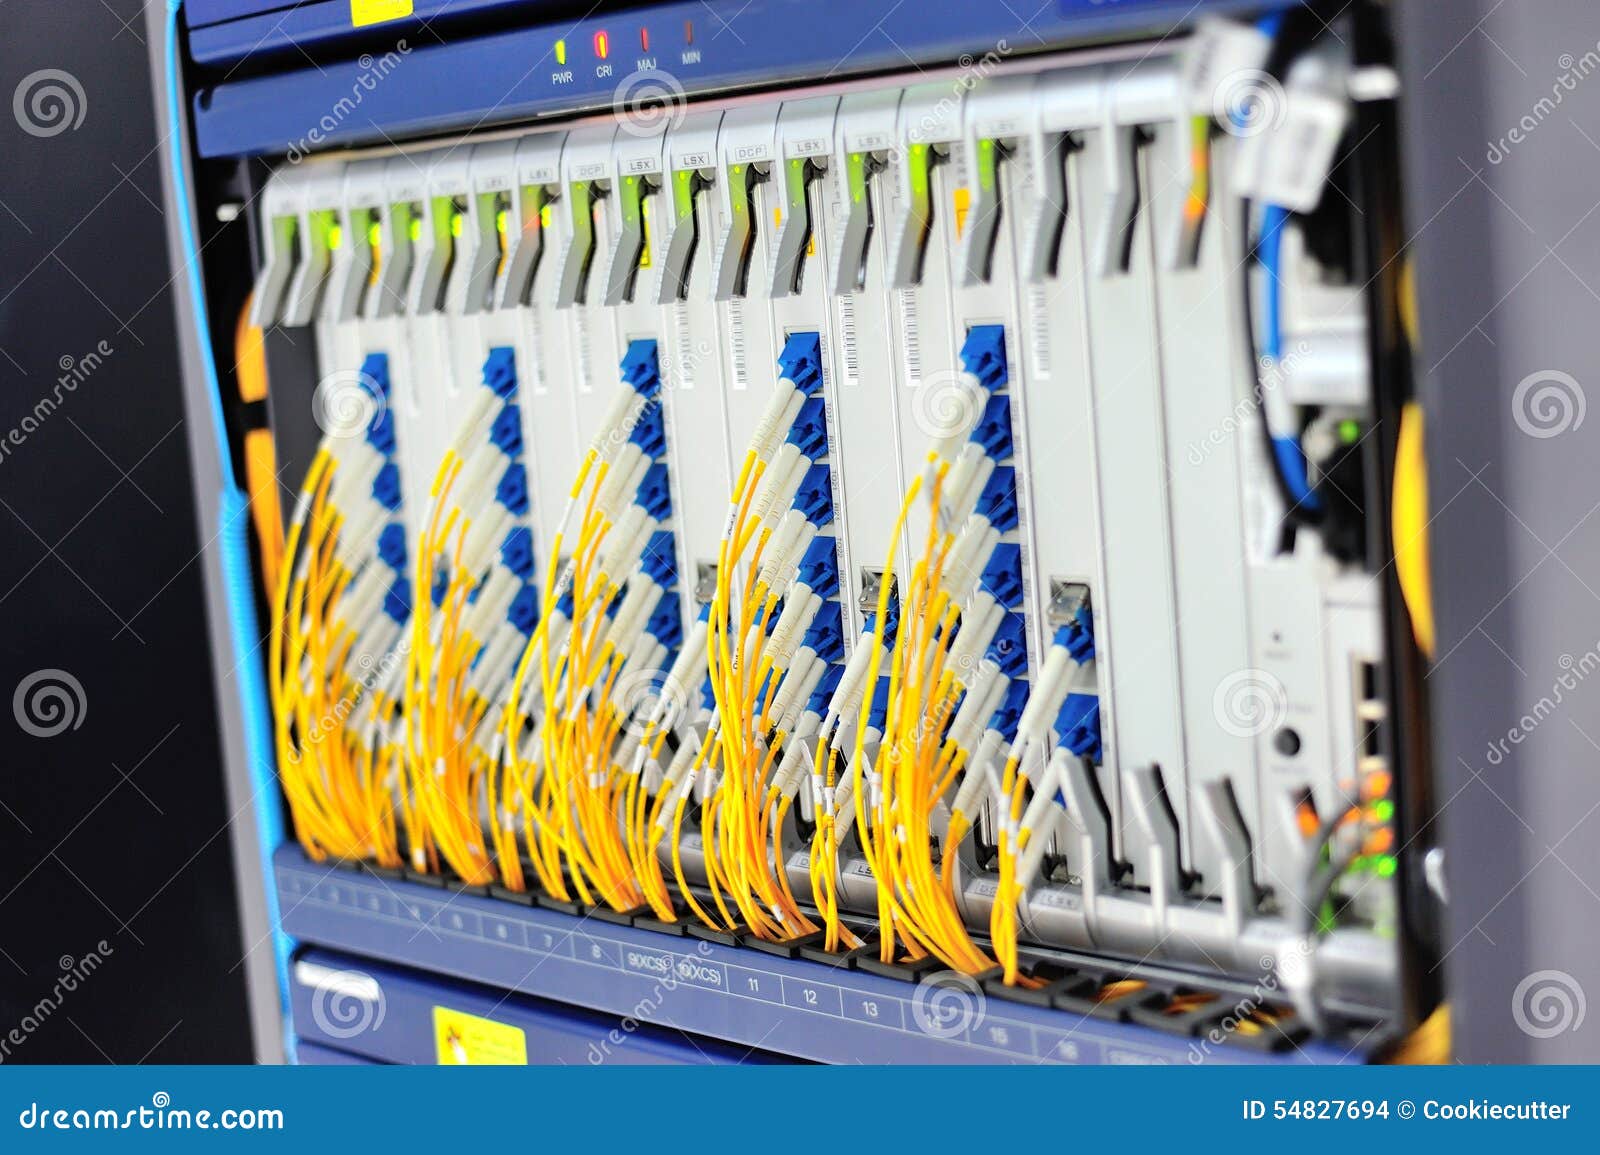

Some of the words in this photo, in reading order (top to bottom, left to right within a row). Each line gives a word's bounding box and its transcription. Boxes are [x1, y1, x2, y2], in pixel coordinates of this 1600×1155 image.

[682, 51, 701, 65] MIN
[596, 65, 612, 78] CRI
[637, 58, 656, 72] MAJ
[552, 71, 573, 85] PWR
[738, 147, 762, 158] DCP
[797, 141, 820, 152] LSX
[630, 161, 651, 171] LSX
[683, 155, 704, 166] LSX
[591, 943, 601, 959] 8
[748, 977, 760, 992] 11
[803, 989, 817, 1005] 12
[862, 1001, 879, 1017] 13
[990, 1026, 1008, 1045] 15
